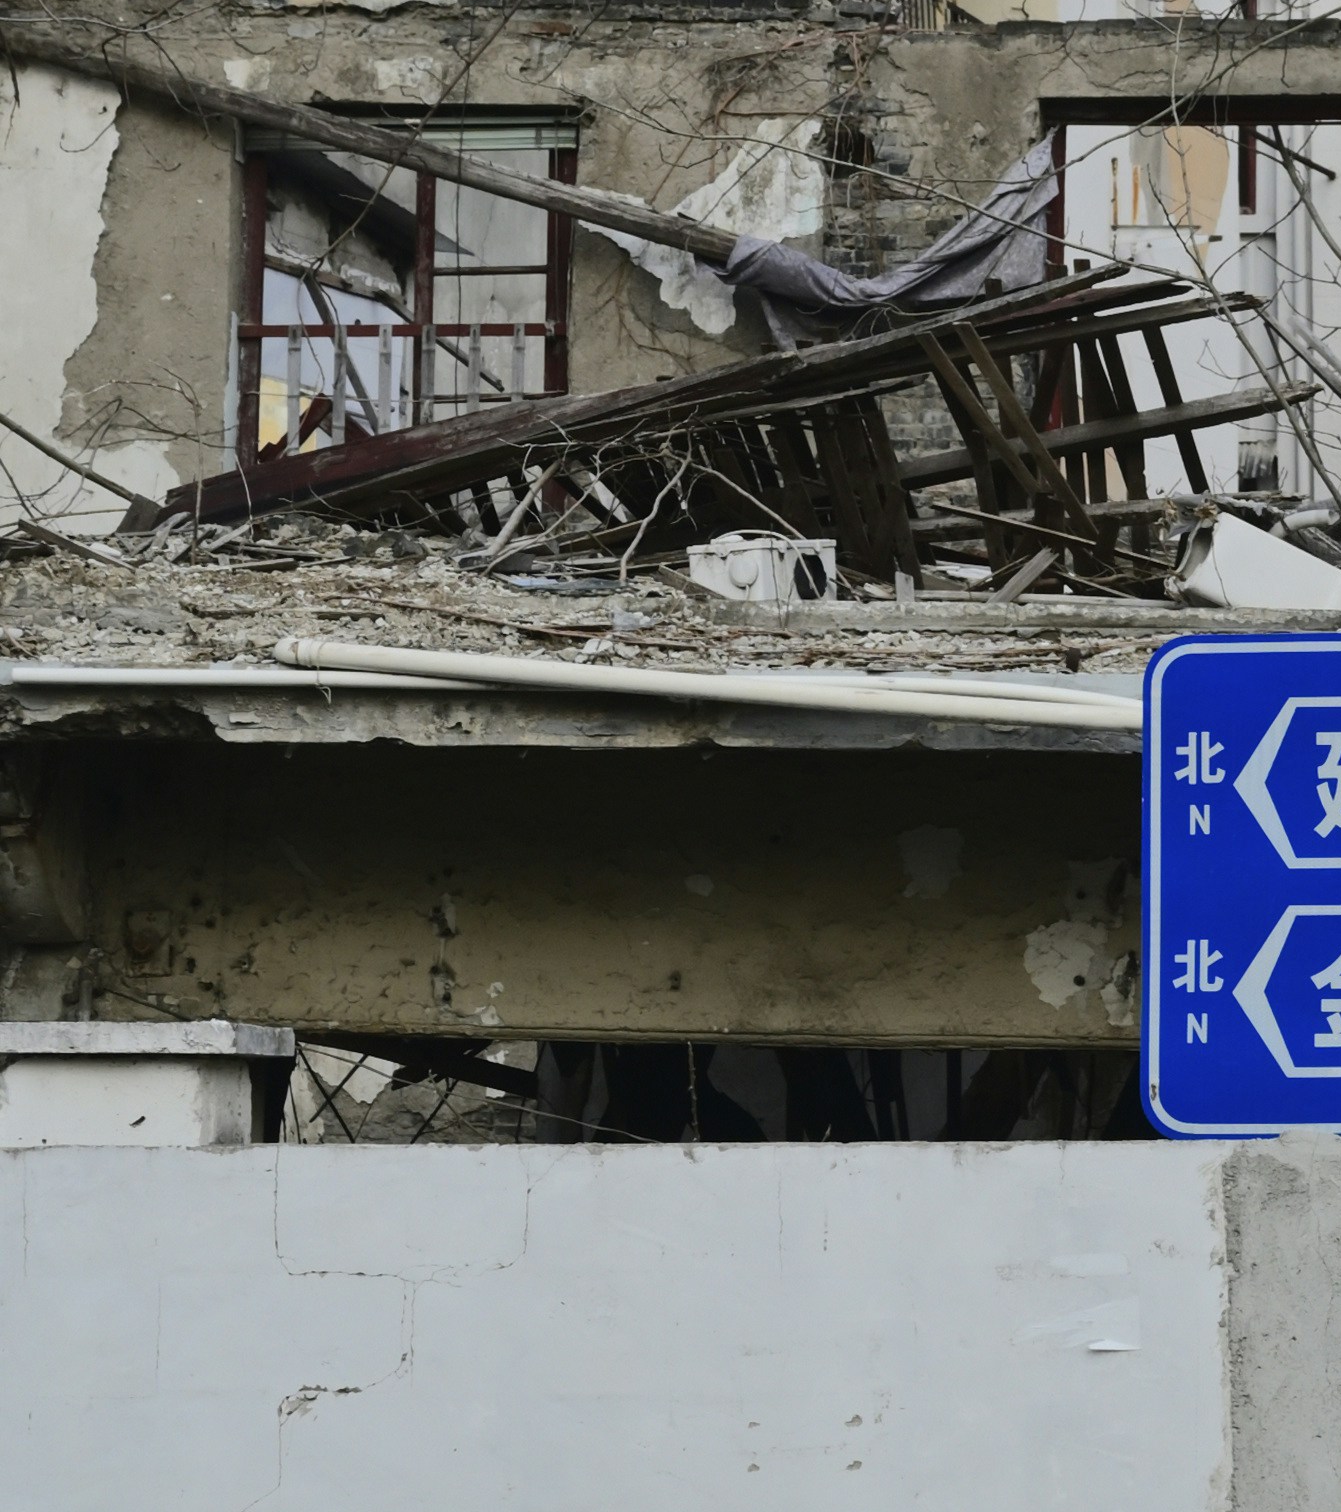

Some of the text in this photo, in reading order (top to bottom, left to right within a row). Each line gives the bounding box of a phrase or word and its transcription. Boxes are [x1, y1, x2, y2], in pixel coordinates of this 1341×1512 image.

[1174, 731, 1225, 786] 北
[1188, 804, 1210, 836] N
[1173, 938, 1225, 994] 北
[1187, 1012, 1208, 1044] N
